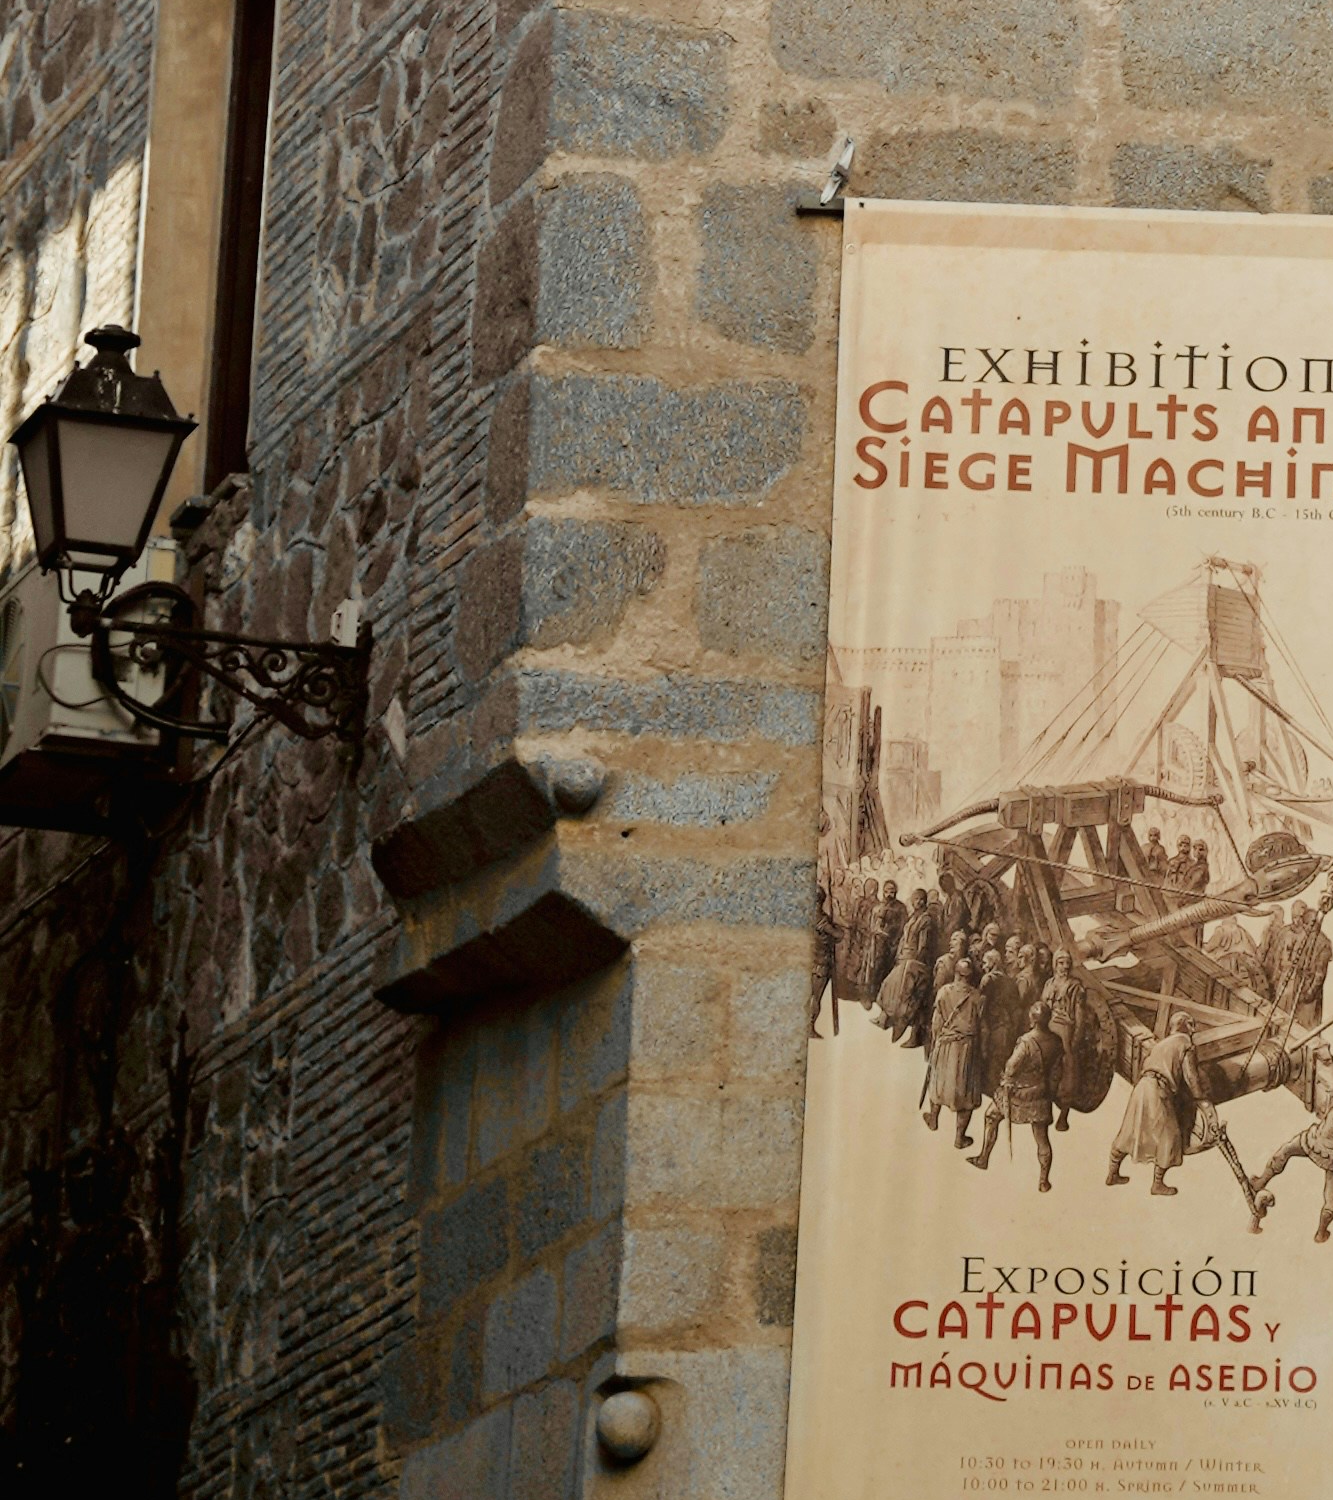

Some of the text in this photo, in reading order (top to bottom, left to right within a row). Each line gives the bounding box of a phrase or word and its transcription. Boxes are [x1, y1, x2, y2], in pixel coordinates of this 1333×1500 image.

[858, 380, 1219, 443] CATAPULTS
[852, 436, 1034, 491] SIEGE
[1165, 505, 1192, 519] (5th
[1197, 507, 1245, 522] century
[1251, 507, 1276, 520] B.C
[1295, 508, 1323, 522] 15th
[893, 1291, 1281, 1343] CATAPULTAS Y
[889, 1351, 1318, 1402] MÁQUINAS DE ASEDIO
[959, 1456, 1006, 1470] 10:30
[1038, 1456, 1084, 1471] 19:30
[962, 1477, 1009, 1491] 10:00
[1041, 1477, 1088, 1492] 21:00
